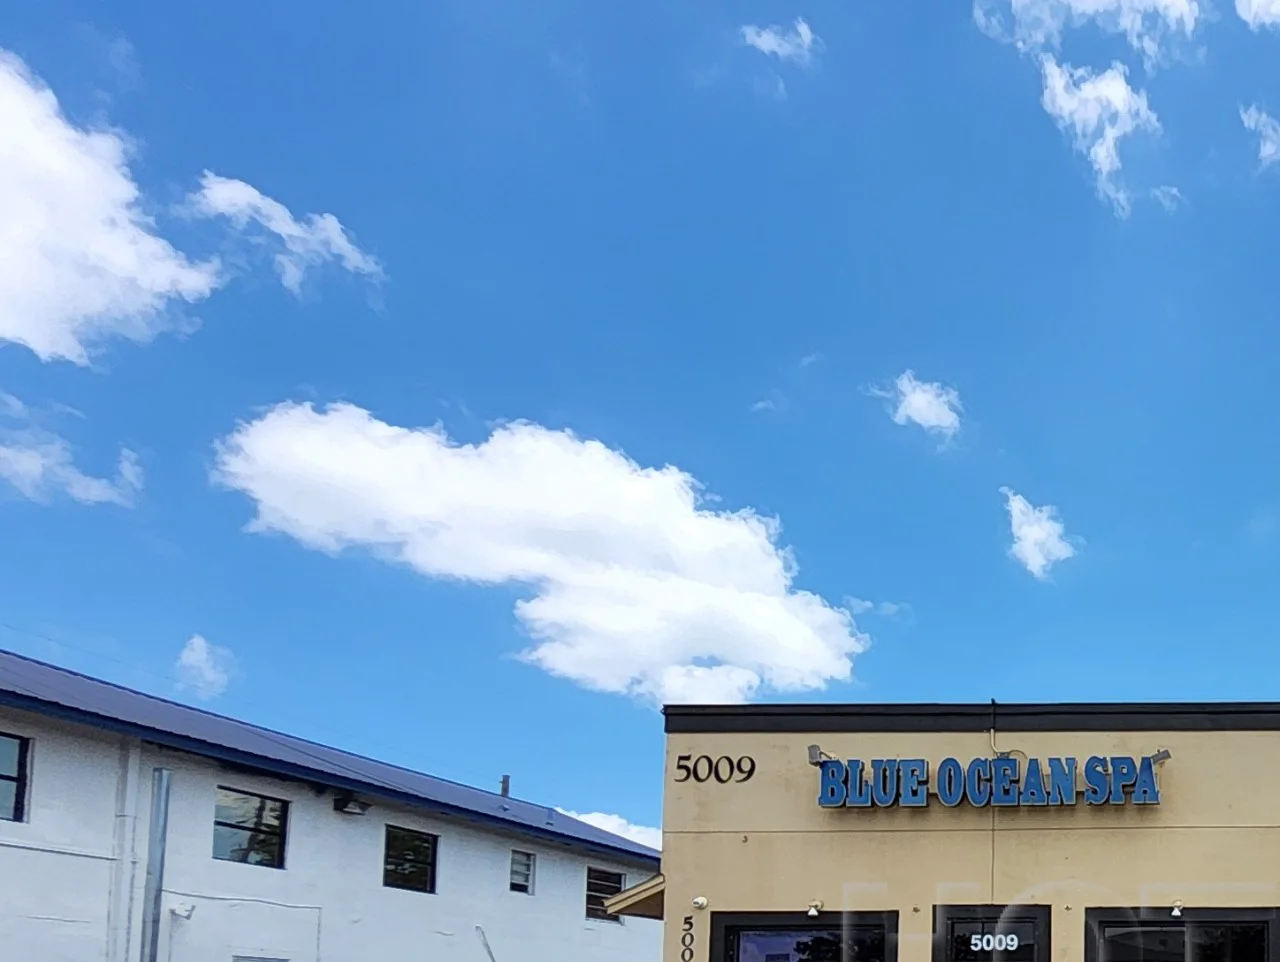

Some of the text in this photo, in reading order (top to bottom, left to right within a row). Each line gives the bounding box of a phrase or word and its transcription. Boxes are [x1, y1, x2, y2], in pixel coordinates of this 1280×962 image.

[674, 754, 756, 784] 5009
[819, 755, 1161, 808] BLUE OCEAN SPA
[970, 934, 1019, 951] 5009
